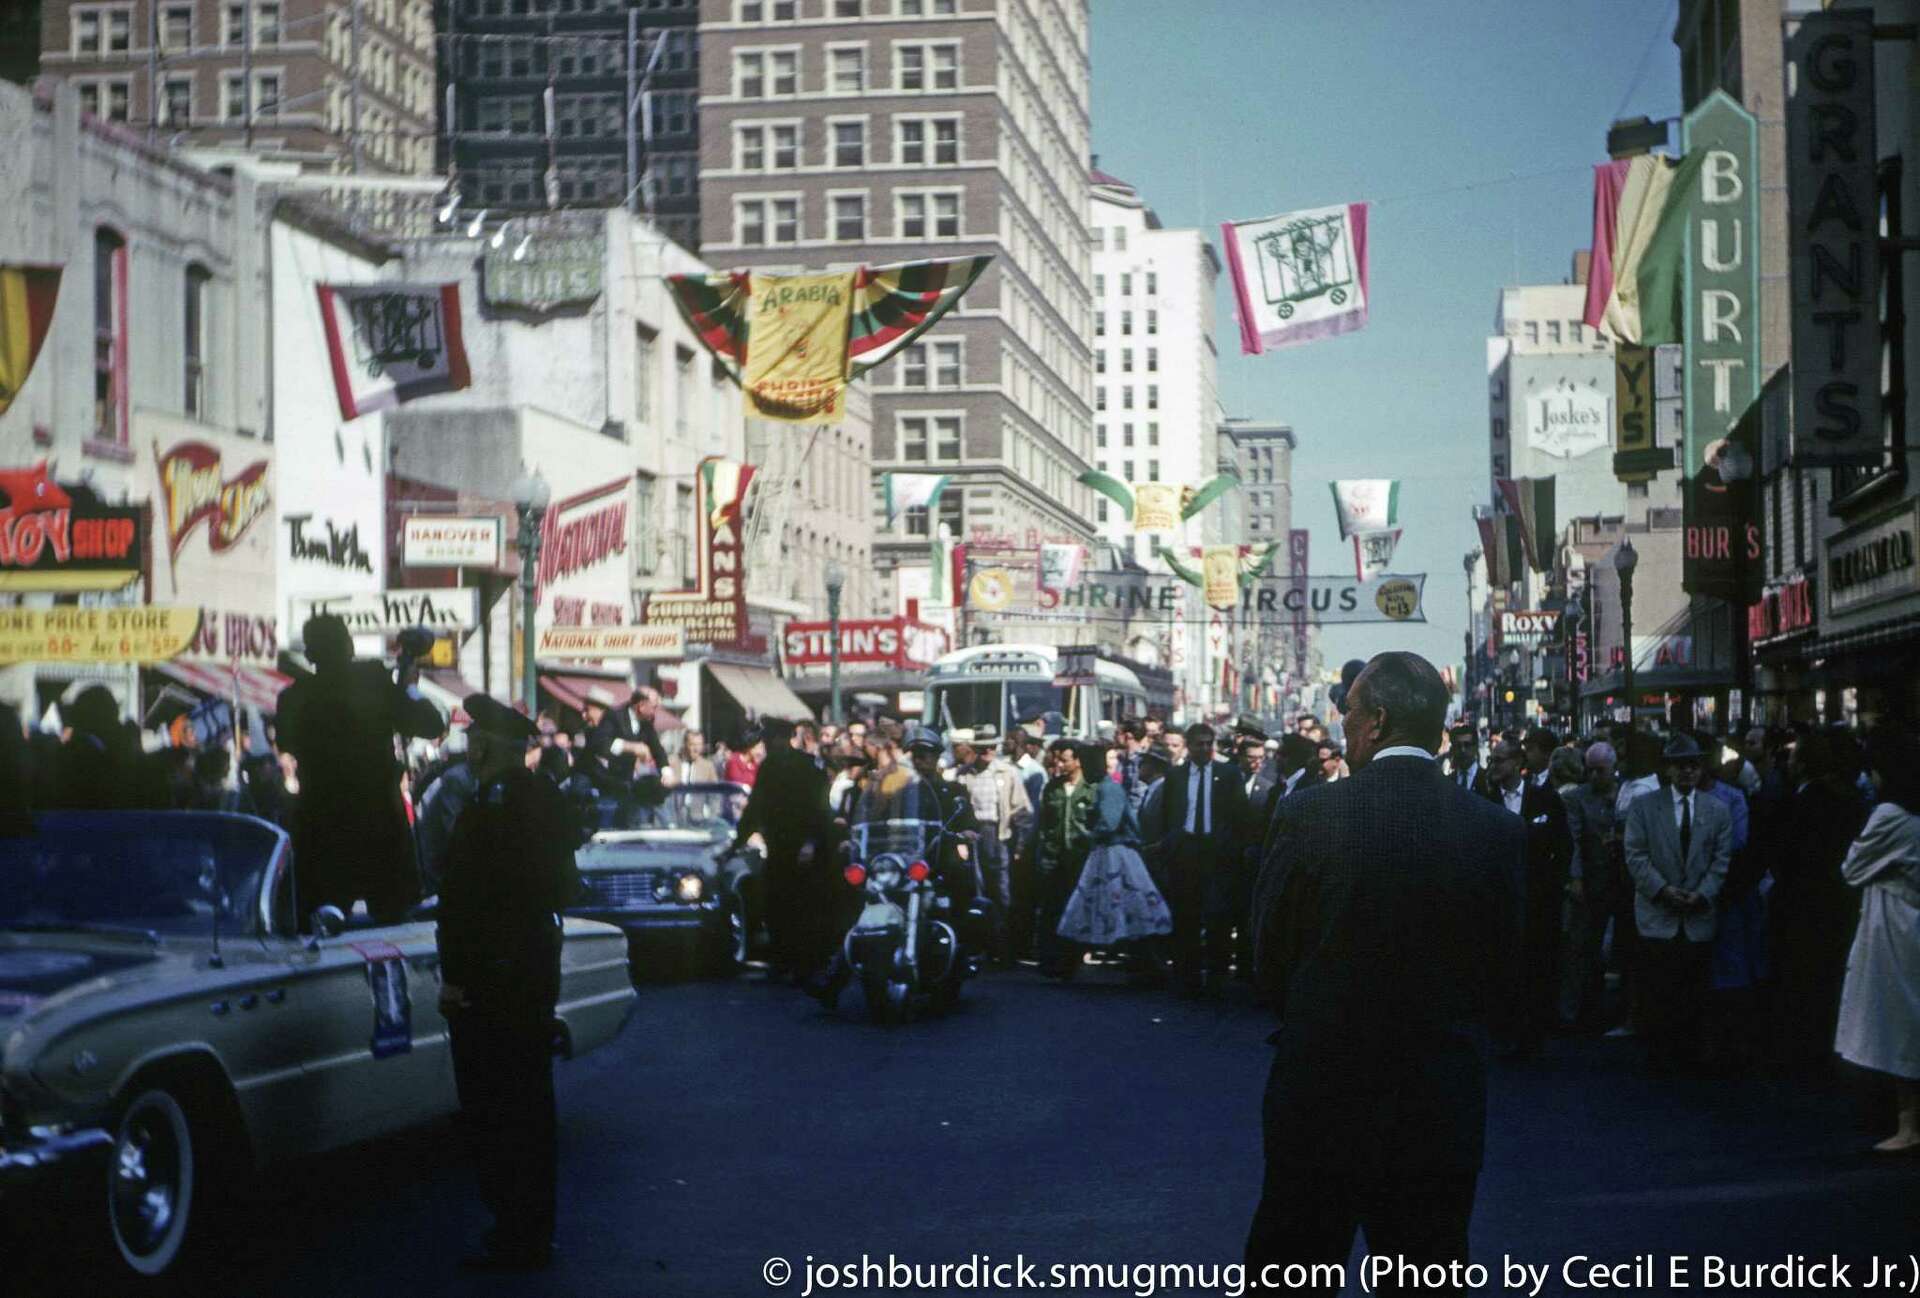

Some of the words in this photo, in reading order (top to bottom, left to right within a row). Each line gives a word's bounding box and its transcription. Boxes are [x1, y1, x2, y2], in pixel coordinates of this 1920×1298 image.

[1807, 34, 1864, 440] GRANTS
[762, 284, 841, 312] ARABIA
[1535, 399, 1600, 433] Joske's
[72, 518, 135, 559] SHOP
[410, 528, 491, 542] HANOVER
[1242, 586, 1358, 614] IRCUS
[45, 610, 97, 629] PRICE
[107, 609, 170, 629] STORE
